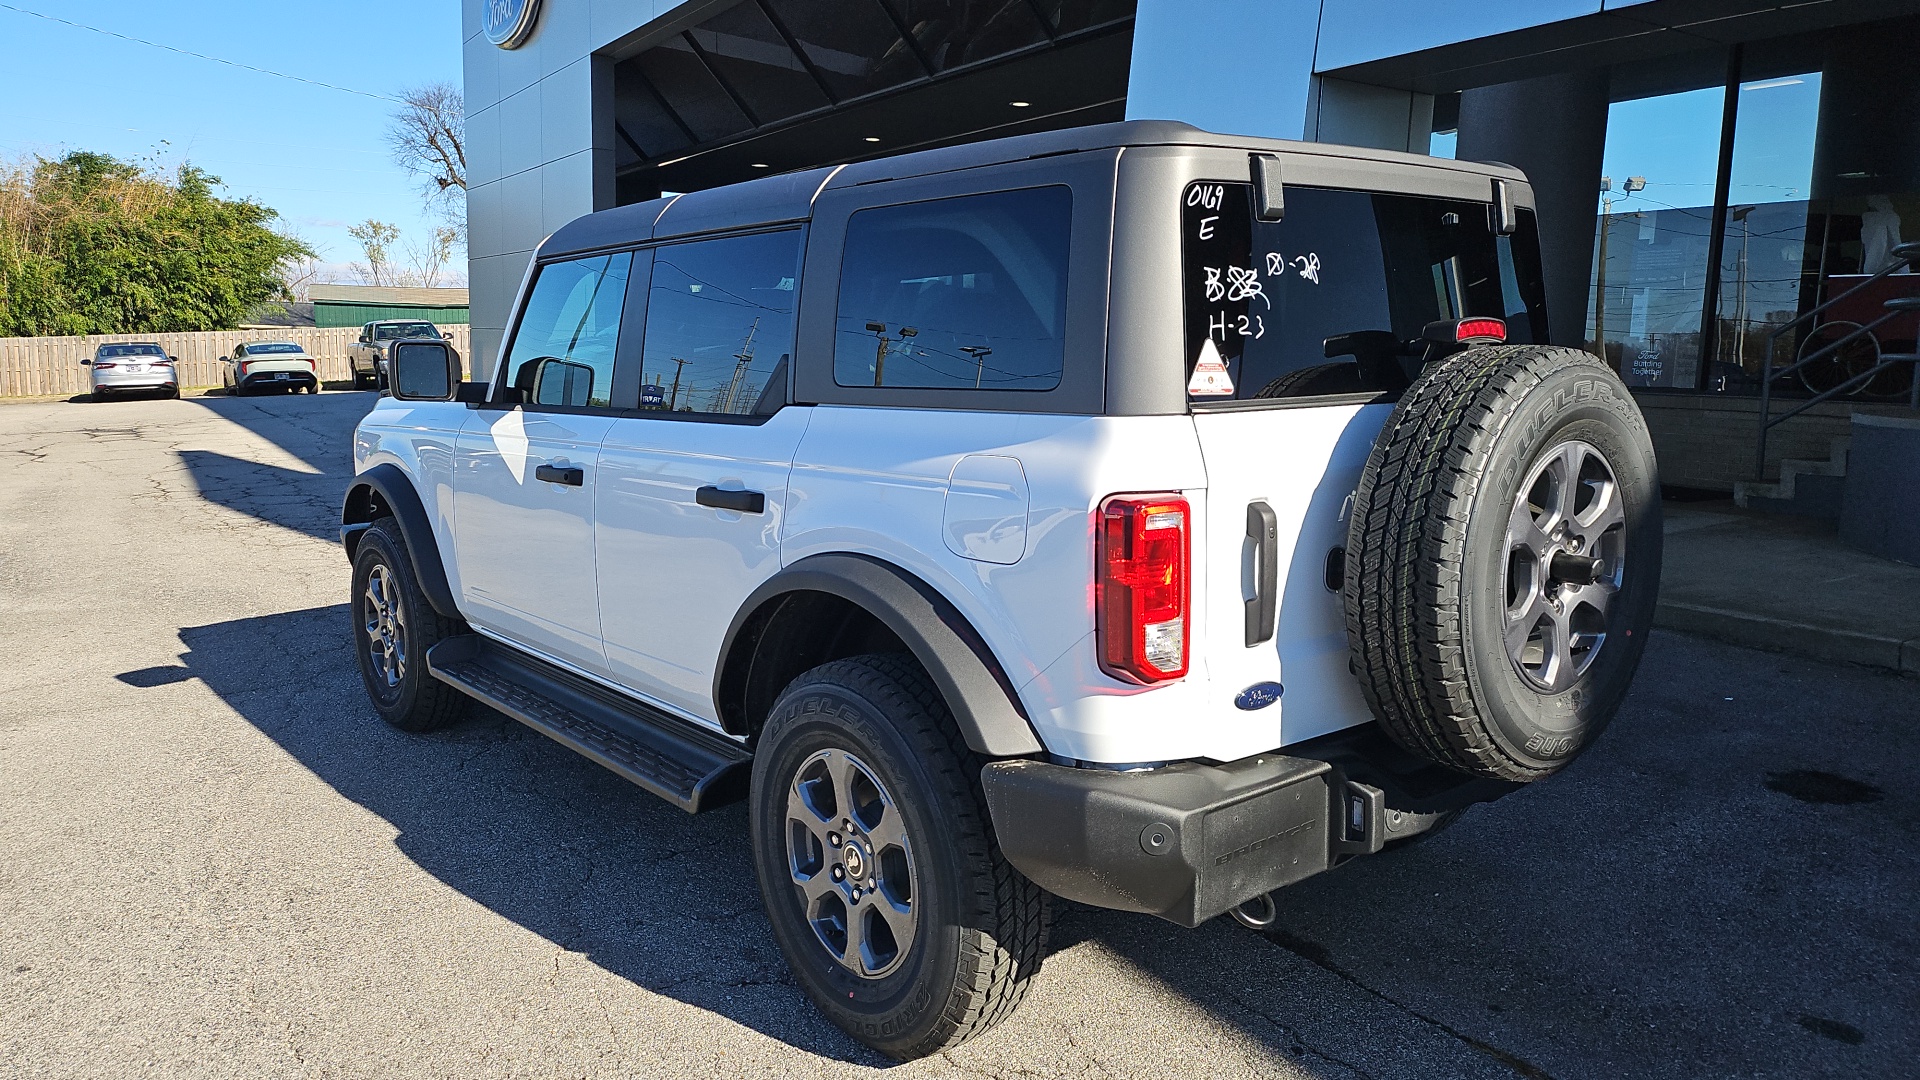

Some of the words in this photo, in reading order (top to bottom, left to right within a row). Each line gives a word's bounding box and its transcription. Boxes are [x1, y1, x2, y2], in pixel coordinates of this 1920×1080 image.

[1187, 184, 1224, 211] 0169
[1199, 216, 1219, 240] E
[1638, 350, 1660, 360] Ford
[1633, 361, 1663, 370] Building
[1631, 367, 1663, 376] Together
